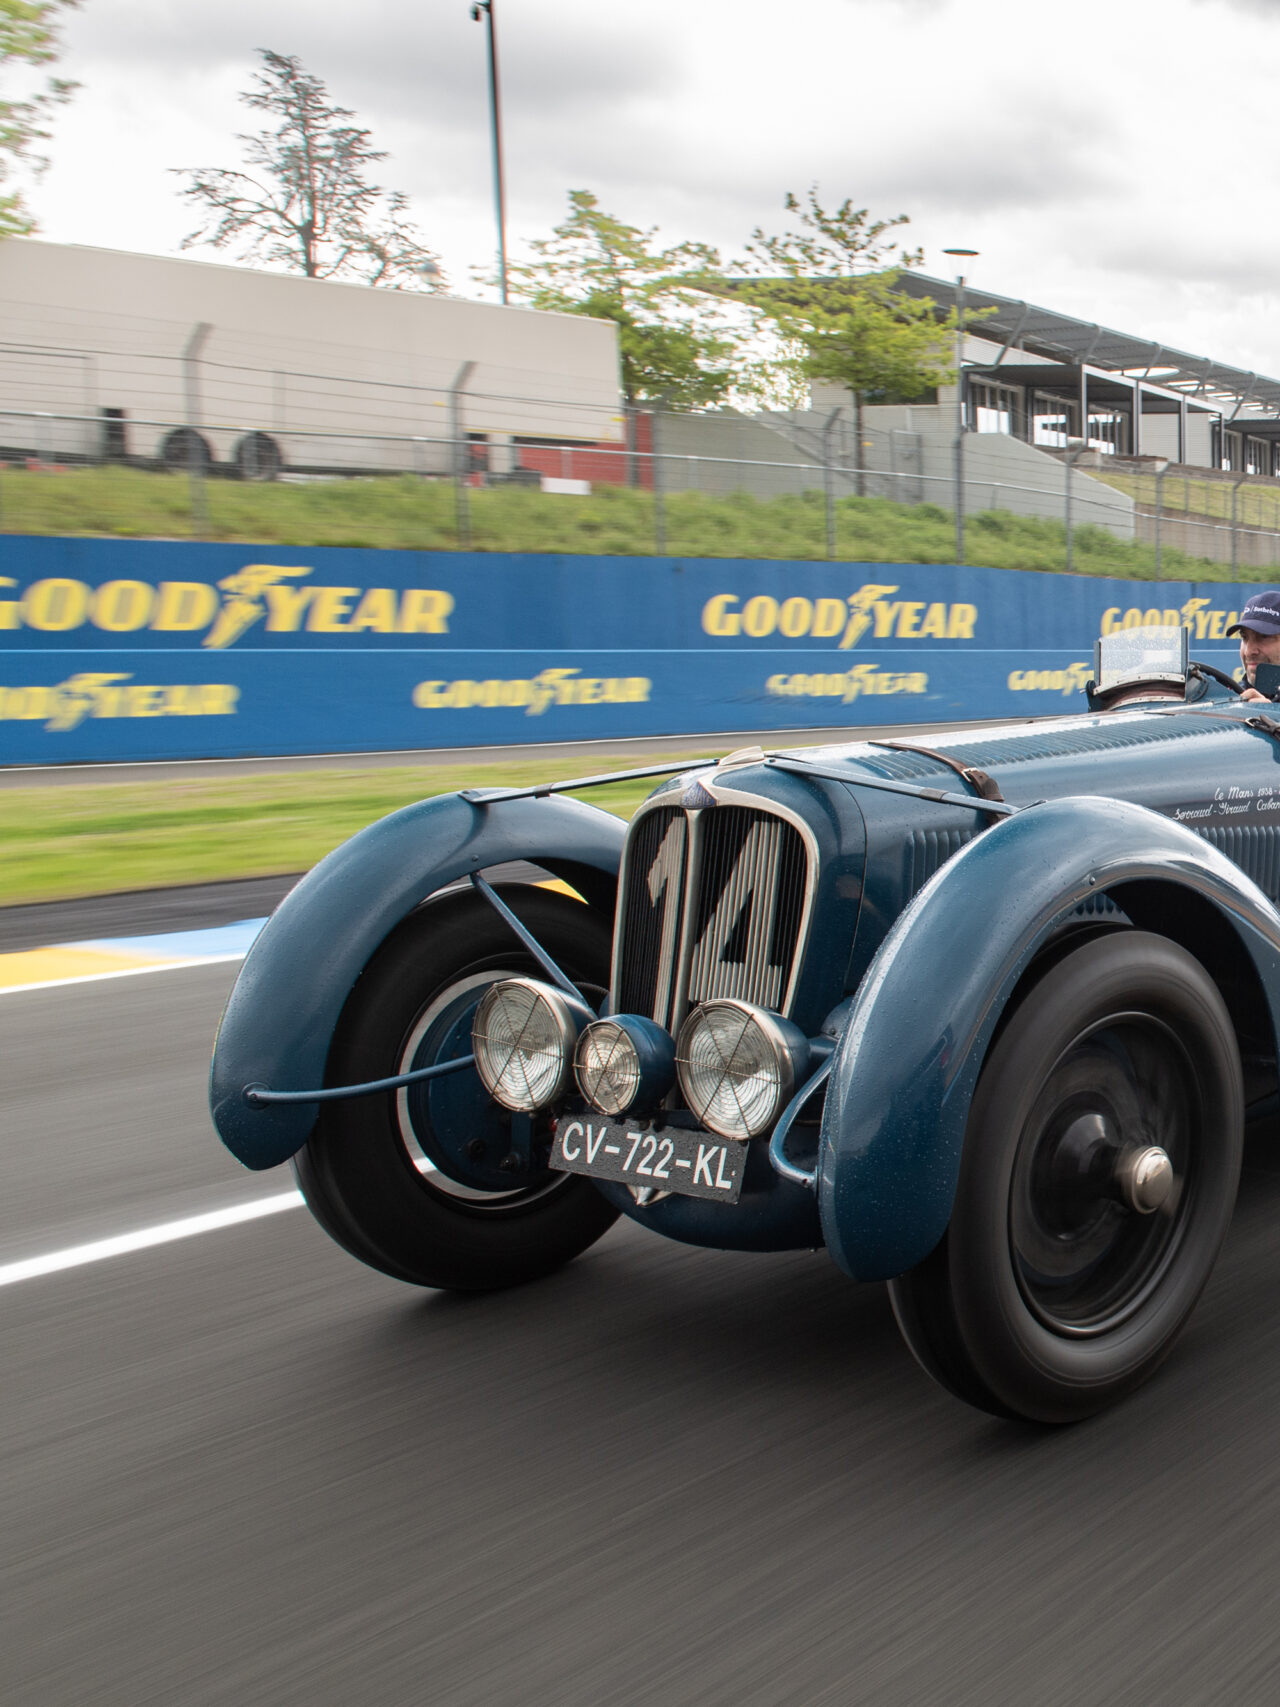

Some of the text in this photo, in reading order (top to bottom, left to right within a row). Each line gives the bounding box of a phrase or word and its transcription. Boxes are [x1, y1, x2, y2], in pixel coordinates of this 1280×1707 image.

[702, 594, 978, 640] GOODYEAR
[1101, 607, 1243, 640] GOODYEA
[412, 677, 652, 708] GOODYEAR
[766, 672, 928, 698] GOODYEAR
[1227, 786, 1254, 799] Mans
[647, 815, 784, 1030] 14
[561, 1121, 733, 1190] CV-722-KL
